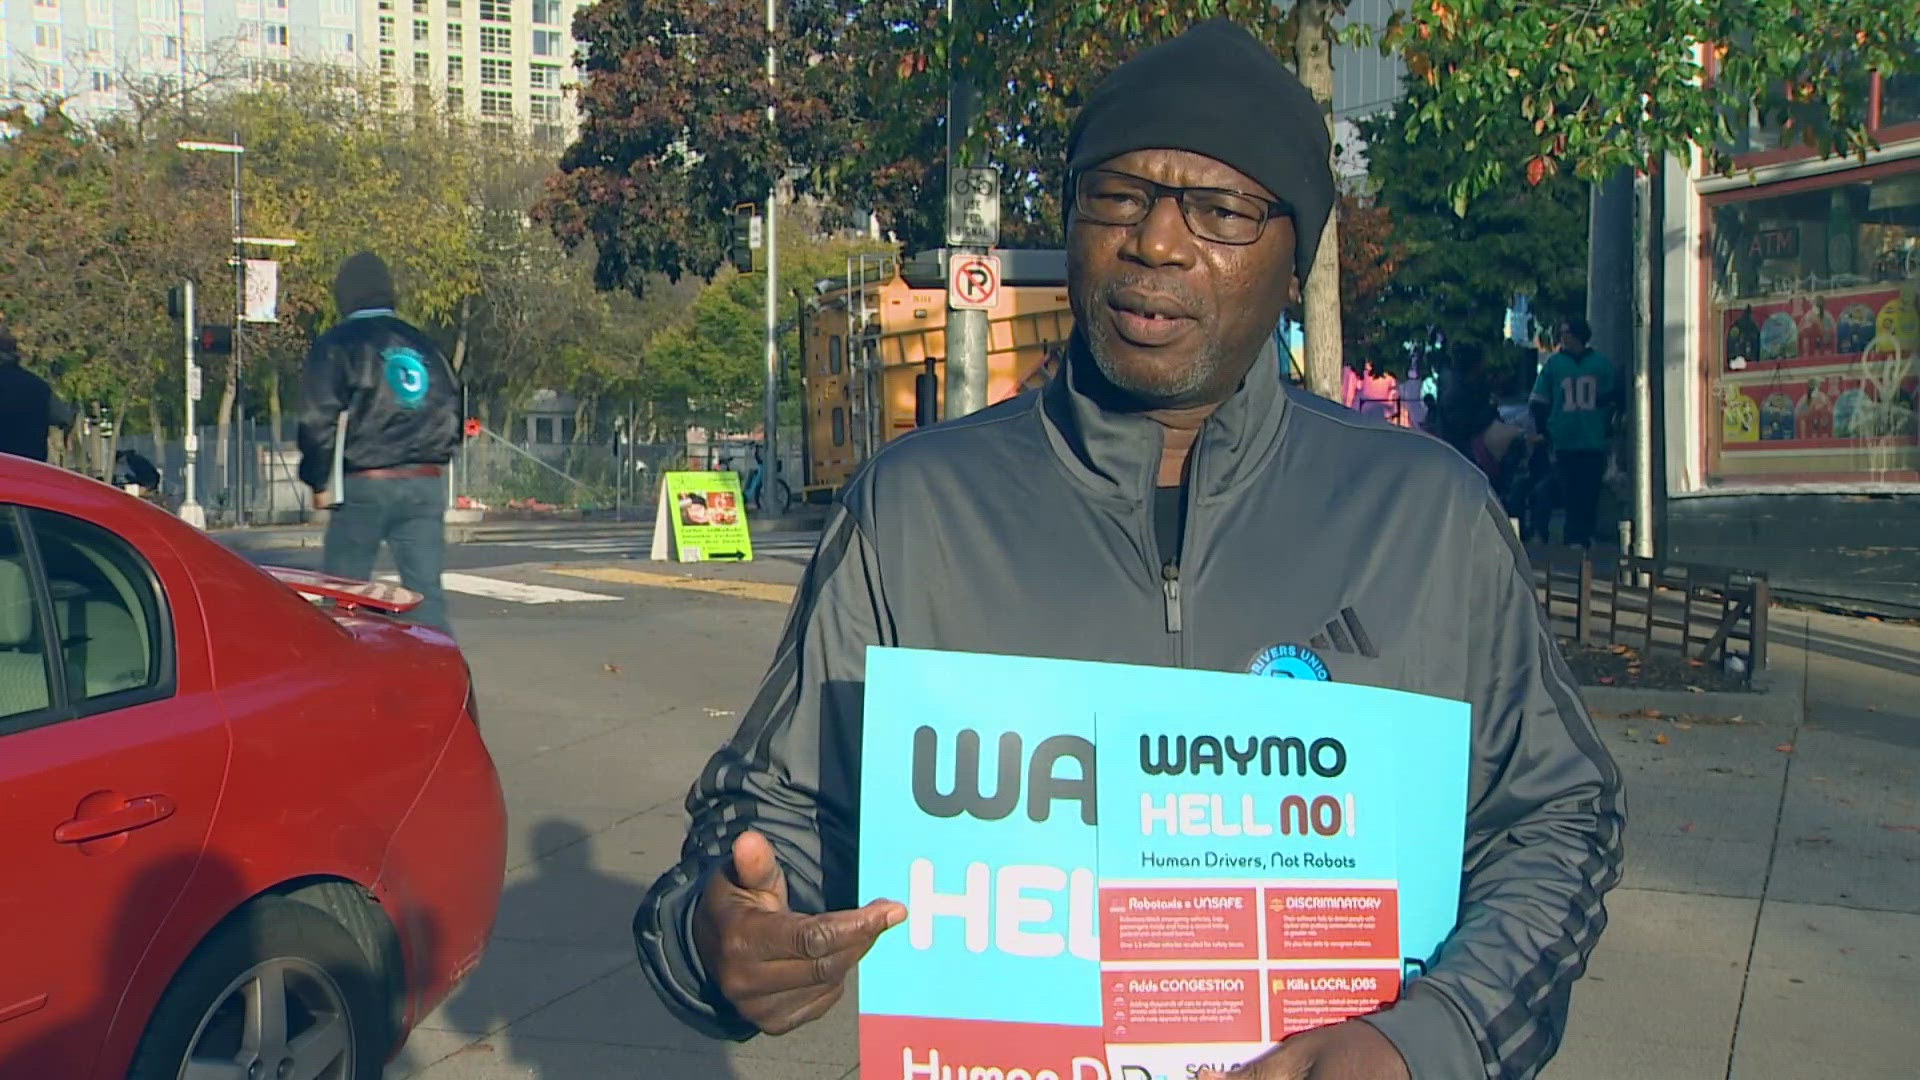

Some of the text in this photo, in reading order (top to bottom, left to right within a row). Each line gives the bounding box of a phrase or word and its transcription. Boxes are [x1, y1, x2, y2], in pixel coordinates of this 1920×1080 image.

[956, 227, 987, 237] SIGNAL
[1751, 229, 1794, 252] ATM
[1561, 376, 1598, 412] 10
[1250, 645, 1329, 681] RIVERS UNIO
[1139, 733, 1347, 778] WAYMO
[1140, 793, 1356, 837] HELL NO!
[1142, 851, 1356, 870] Human Drivers, Not Robots
[1129, 897, 1183, 910] Robotaxis
[1193, 897, 1244, 910] UNSAFE
[1286, 896, 1381, 909] DISCRIMINATORY
[1129, 979, 1244, 993] Adds CONGESTION
[1287, 978, 1377, 992] Kills LOCAL JOBS
